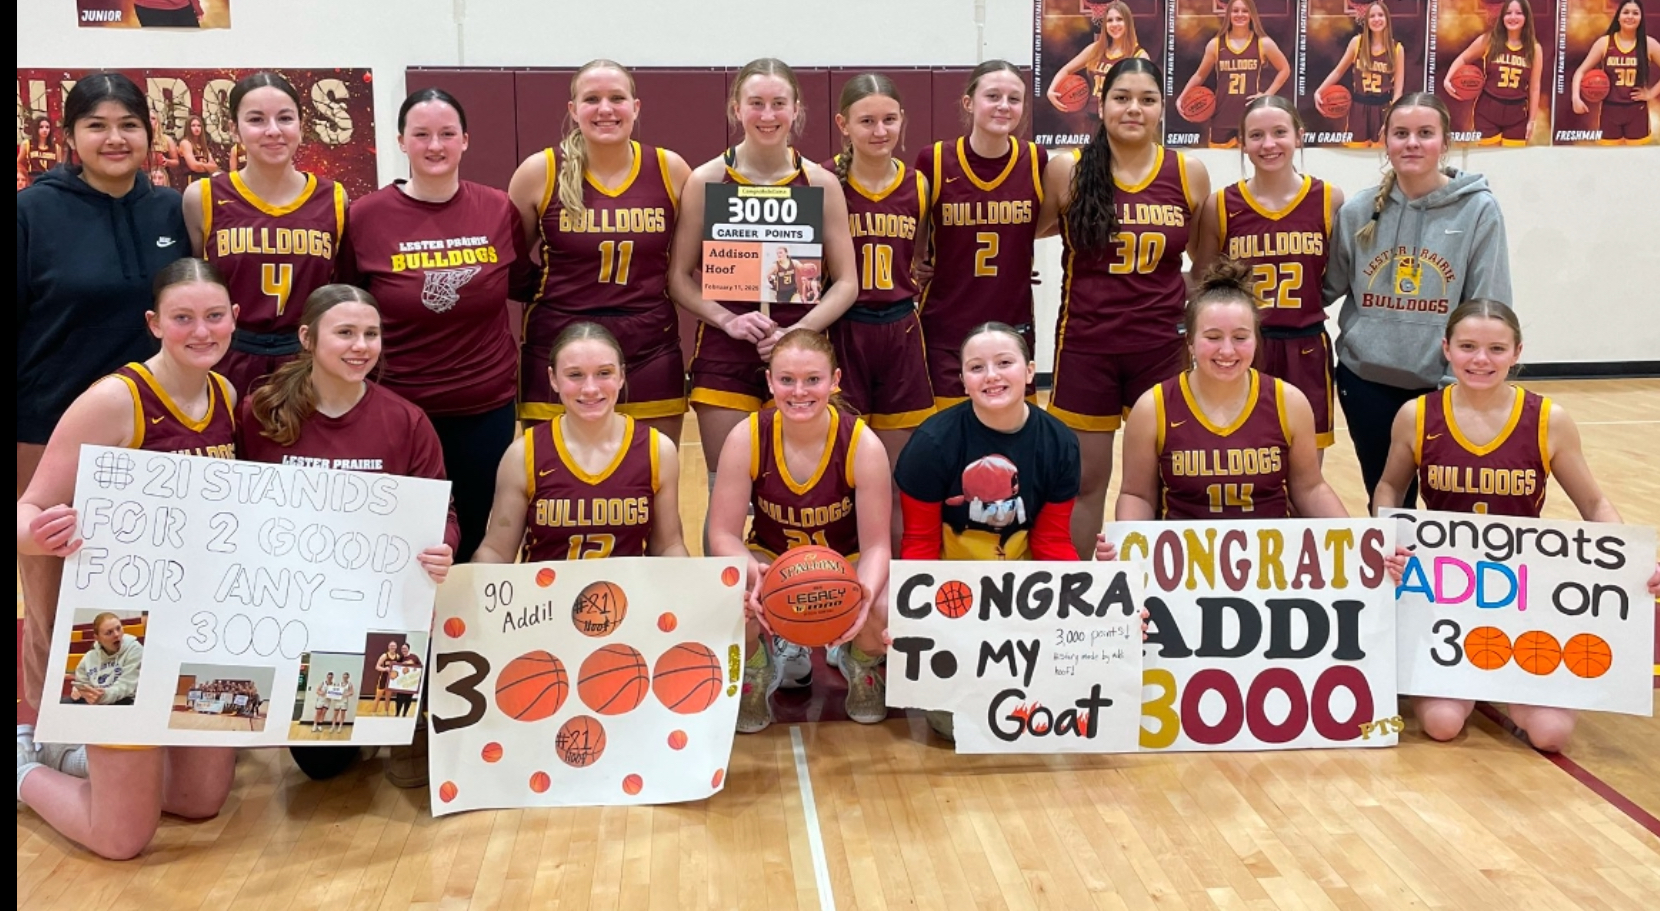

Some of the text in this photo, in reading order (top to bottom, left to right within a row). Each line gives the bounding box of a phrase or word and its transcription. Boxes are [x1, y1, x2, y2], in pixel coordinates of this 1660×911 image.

[81, 9, 122, 23] JUNIOR
[1228, 73, 1246, 95] 21
[1497, 66, 1522, 89] 35
[1614, 68, 1637, 87] 30
[1035, 134, 1091, 145] 8TH GRADER
[1167, 133, 1200, 145] SENIOR
[1303, 132, 1354, 143] TH GRADER
[1555, 130, 1603, 142] FRESHMAN
[559, 207, 666, 233] BULLDOGS
[728, 197, 798, 223] 3000
[942, 200, 1032, 226] BULLDOGS
[217, 227, 332, 260] BULLDOGS
[399, 236, 488, 252] LESTER PRAIRIE
[717, 229, 804, 239] CAREER POINTS
[1229, 232, 1323, 260] BULLDOGS
[391, 246, 498, 272] BULLDOGS
[598, 240, 634, 286] 11
[709, 248, 759, 259] Addison
[974, 232, 1000, 277] 2
[1109, 231, 1166, 274] 30
[705, 264, 736, 275] Hoof
[862, 243, 894, 290] 10
[261, 263, 293, 317] 4
[1252, 262, 1303, 309] 22
[1362, 293, 1449, 314] BULLDOGS
[282, 455, 383, 469] LESTER PRAIRIE
[1171, 446, 1282, 477] BULLDOGS
[200, 462, 400, 515] STANDS
[1427, 465, 1537, 496] BULLDOGS
[1206, 483, 1255, 513] 14
[536, 496, 649, 527] BULLDOGS
[81, 498, 410, 574] FOR 2 GOOD
[75, 547, 185, 603] FOR
[780, 560, 846, 582] SPALDING
[787, 587, 846, 604] LEGACY
[1395, 556, 1630, 621] ADDI on
[573, 592, 611, 614] #21
[502, 600, 553, 633] Addi!
[1142, 596, 1366, 661] ADDI
[187, 611, 309, 660] 3000
[1055, 623, 1130, 647] 3,000 points!
[1139, 665, 1375, 749] 3000
[1357, 715, 1405, 740] PTS
